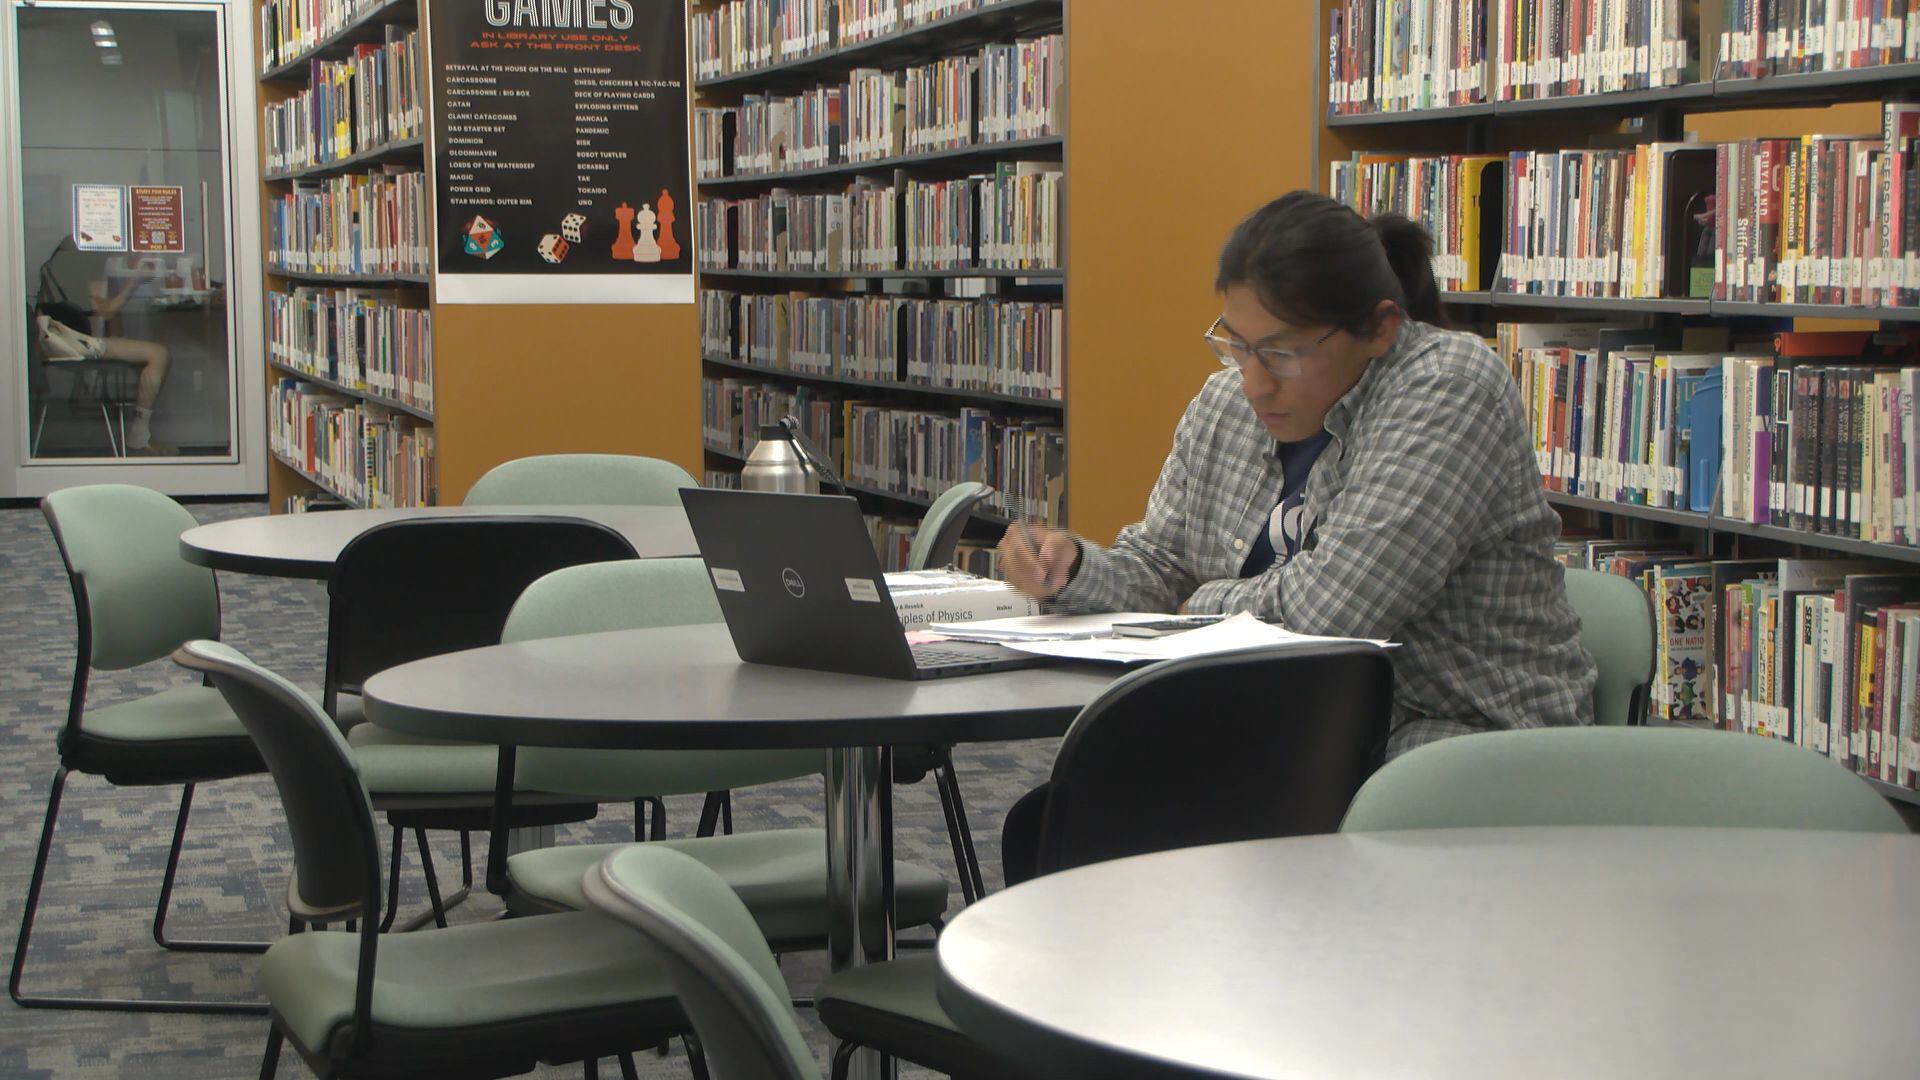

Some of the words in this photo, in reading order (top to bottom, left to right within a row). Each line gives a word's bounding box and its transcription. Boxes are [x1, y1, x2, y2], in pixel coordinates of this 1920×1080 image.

[482, 32, 494, 40] IN
[485, 0, 634, 30] GAMES
[470, 41, 497, 49] ASK
[556, 43, 600, 51] FRONT
[1789, 151, 1798, 193] NATIONAL
[1882, 111, 1892, 202] PIONEERS
[1759, 151, 1770, 216] GUYLAND
[1798, 160, 1806, 246] MEDIOCRE
[1737, 218, 1748, 262] Stiffed
[1788, 197, 1796, 242] MANHOOD
[1881, 213, 1890, 299] POSSE
[786, 579, 802, 588] DELL
[900, 613, 923, 624] iples
[926, 612, 935, 622] of
[938, 610, 973, 623] Physics
[1670, 637, 1683, 646] ONE
[1685, 636, 1704, 645] NATIO
